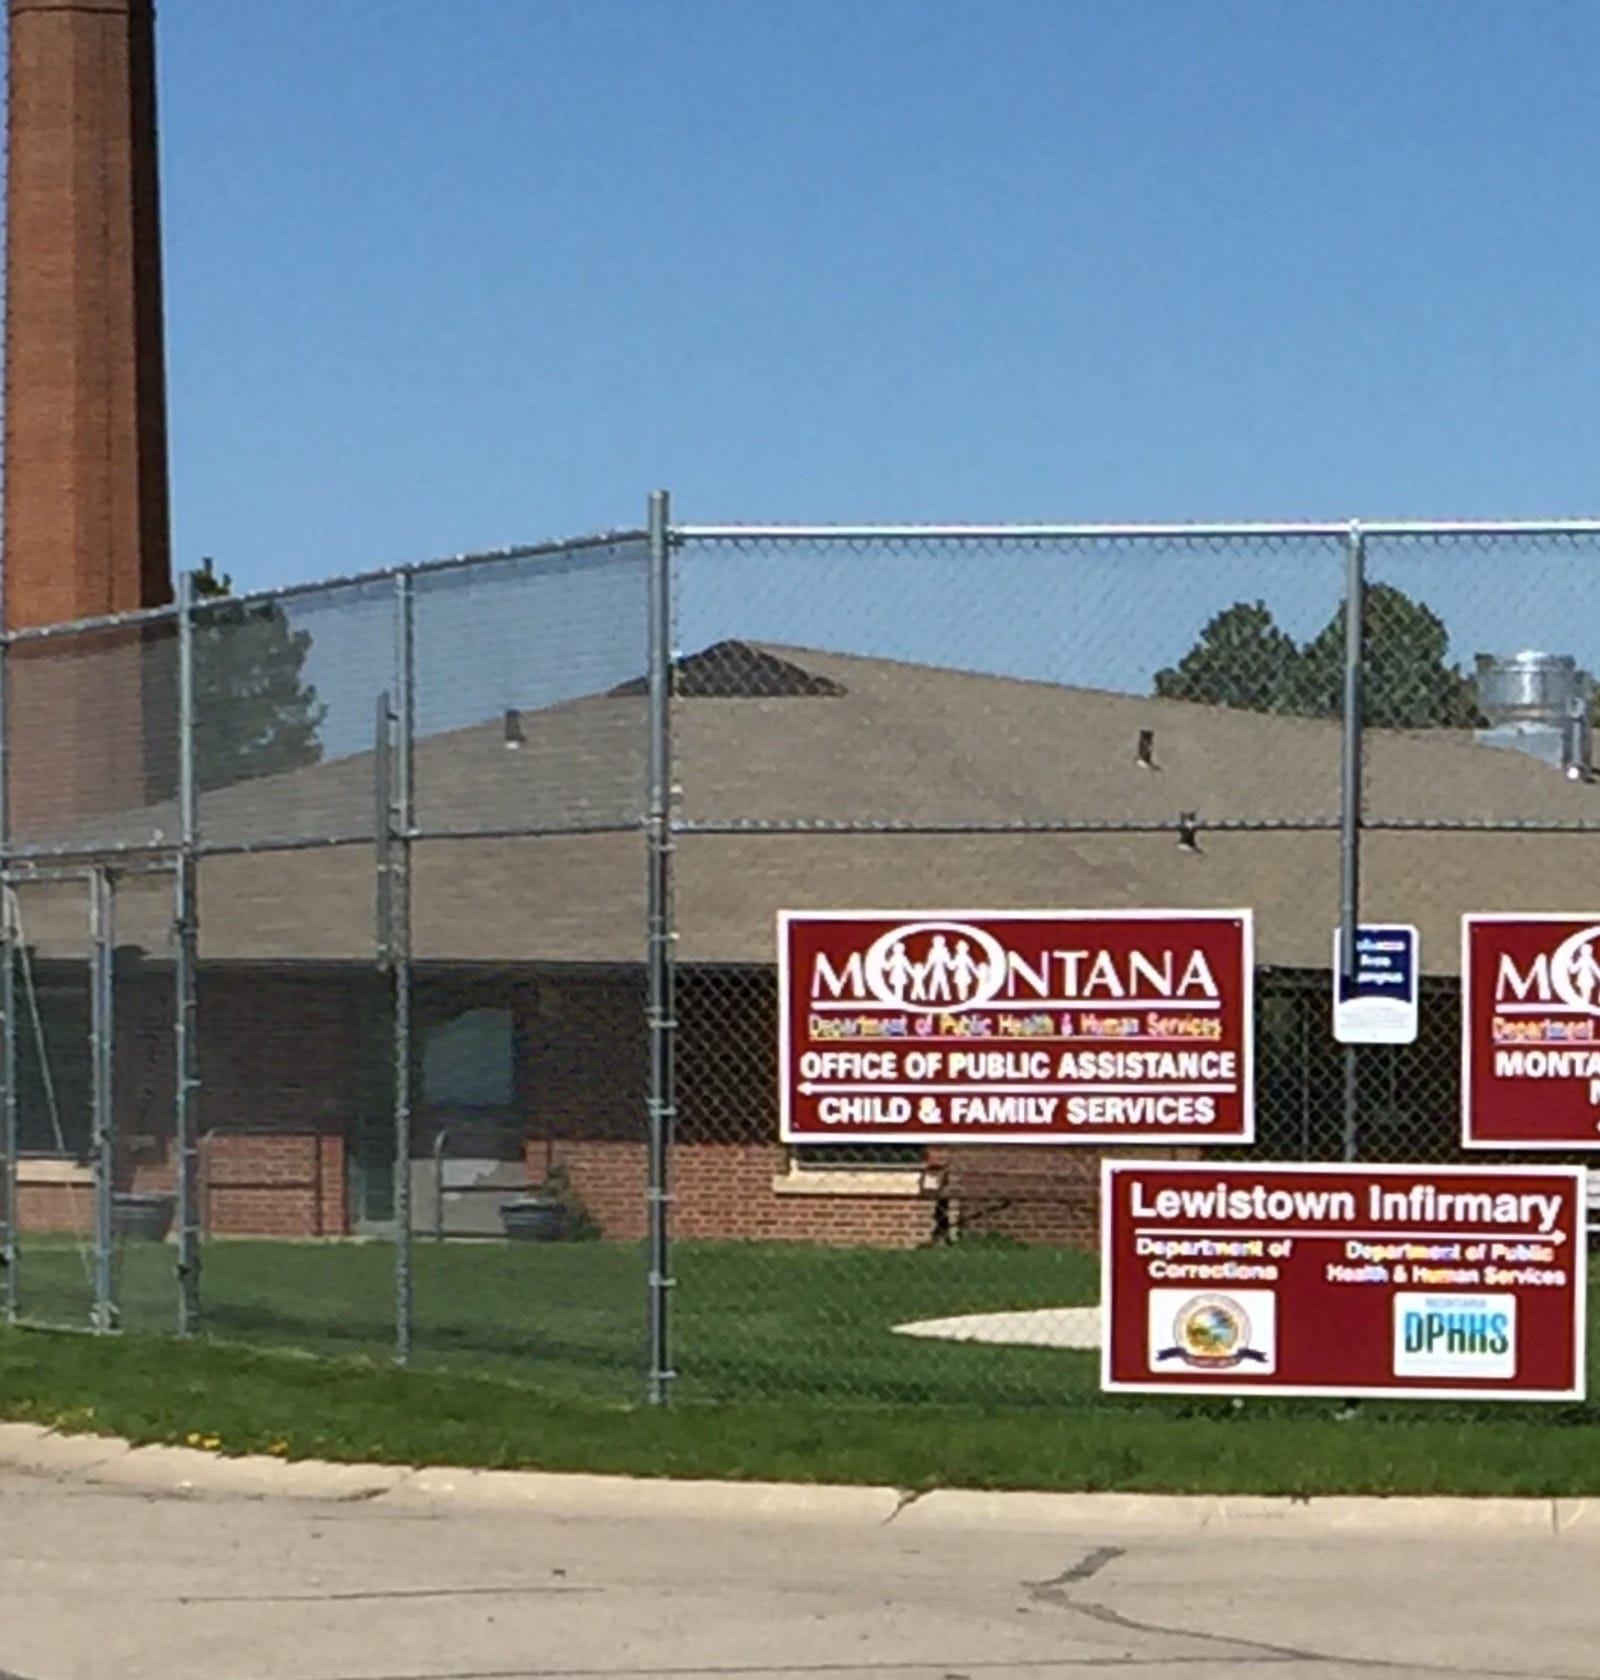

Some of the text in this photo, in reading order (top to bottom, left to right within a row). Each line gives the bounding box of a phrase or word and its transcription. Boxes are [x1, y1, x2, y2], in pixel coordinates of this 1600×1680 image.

[811, 922, 1219, 1013] MONTANA
[808, 1013, 908, 1039] Department
[915, 1014, 932, 1035] of
[939, 1014, 992, 1036] Public
[1000, 1014, 1055, 1036] Health
[1147, 1014, 1222, 1037] Services
[1492, 1017, 1594, 1042] Department
[801, 1052, 1236, 1079] OFFICE OF PUBLIC ASSISTANCE
[818, 1098, 1215, 1124] CHILD & FAMILY SERVICES
[1131, 1181, 1563, 1231] Lewistown Infirmary
[1137, 1238, 1291, 1258] Department of
[1346, 1241, 1554, 1262] Department of Public
[1149, 1261, 1278, 1279] Corrections
[1327, 1263, 1389, 1283] Health
[1412, 1265, 1479, 1285] Human
[1484, 1266, 1567, 1287] Services
[1404, 1312, 1509, 1355] DPHHS
